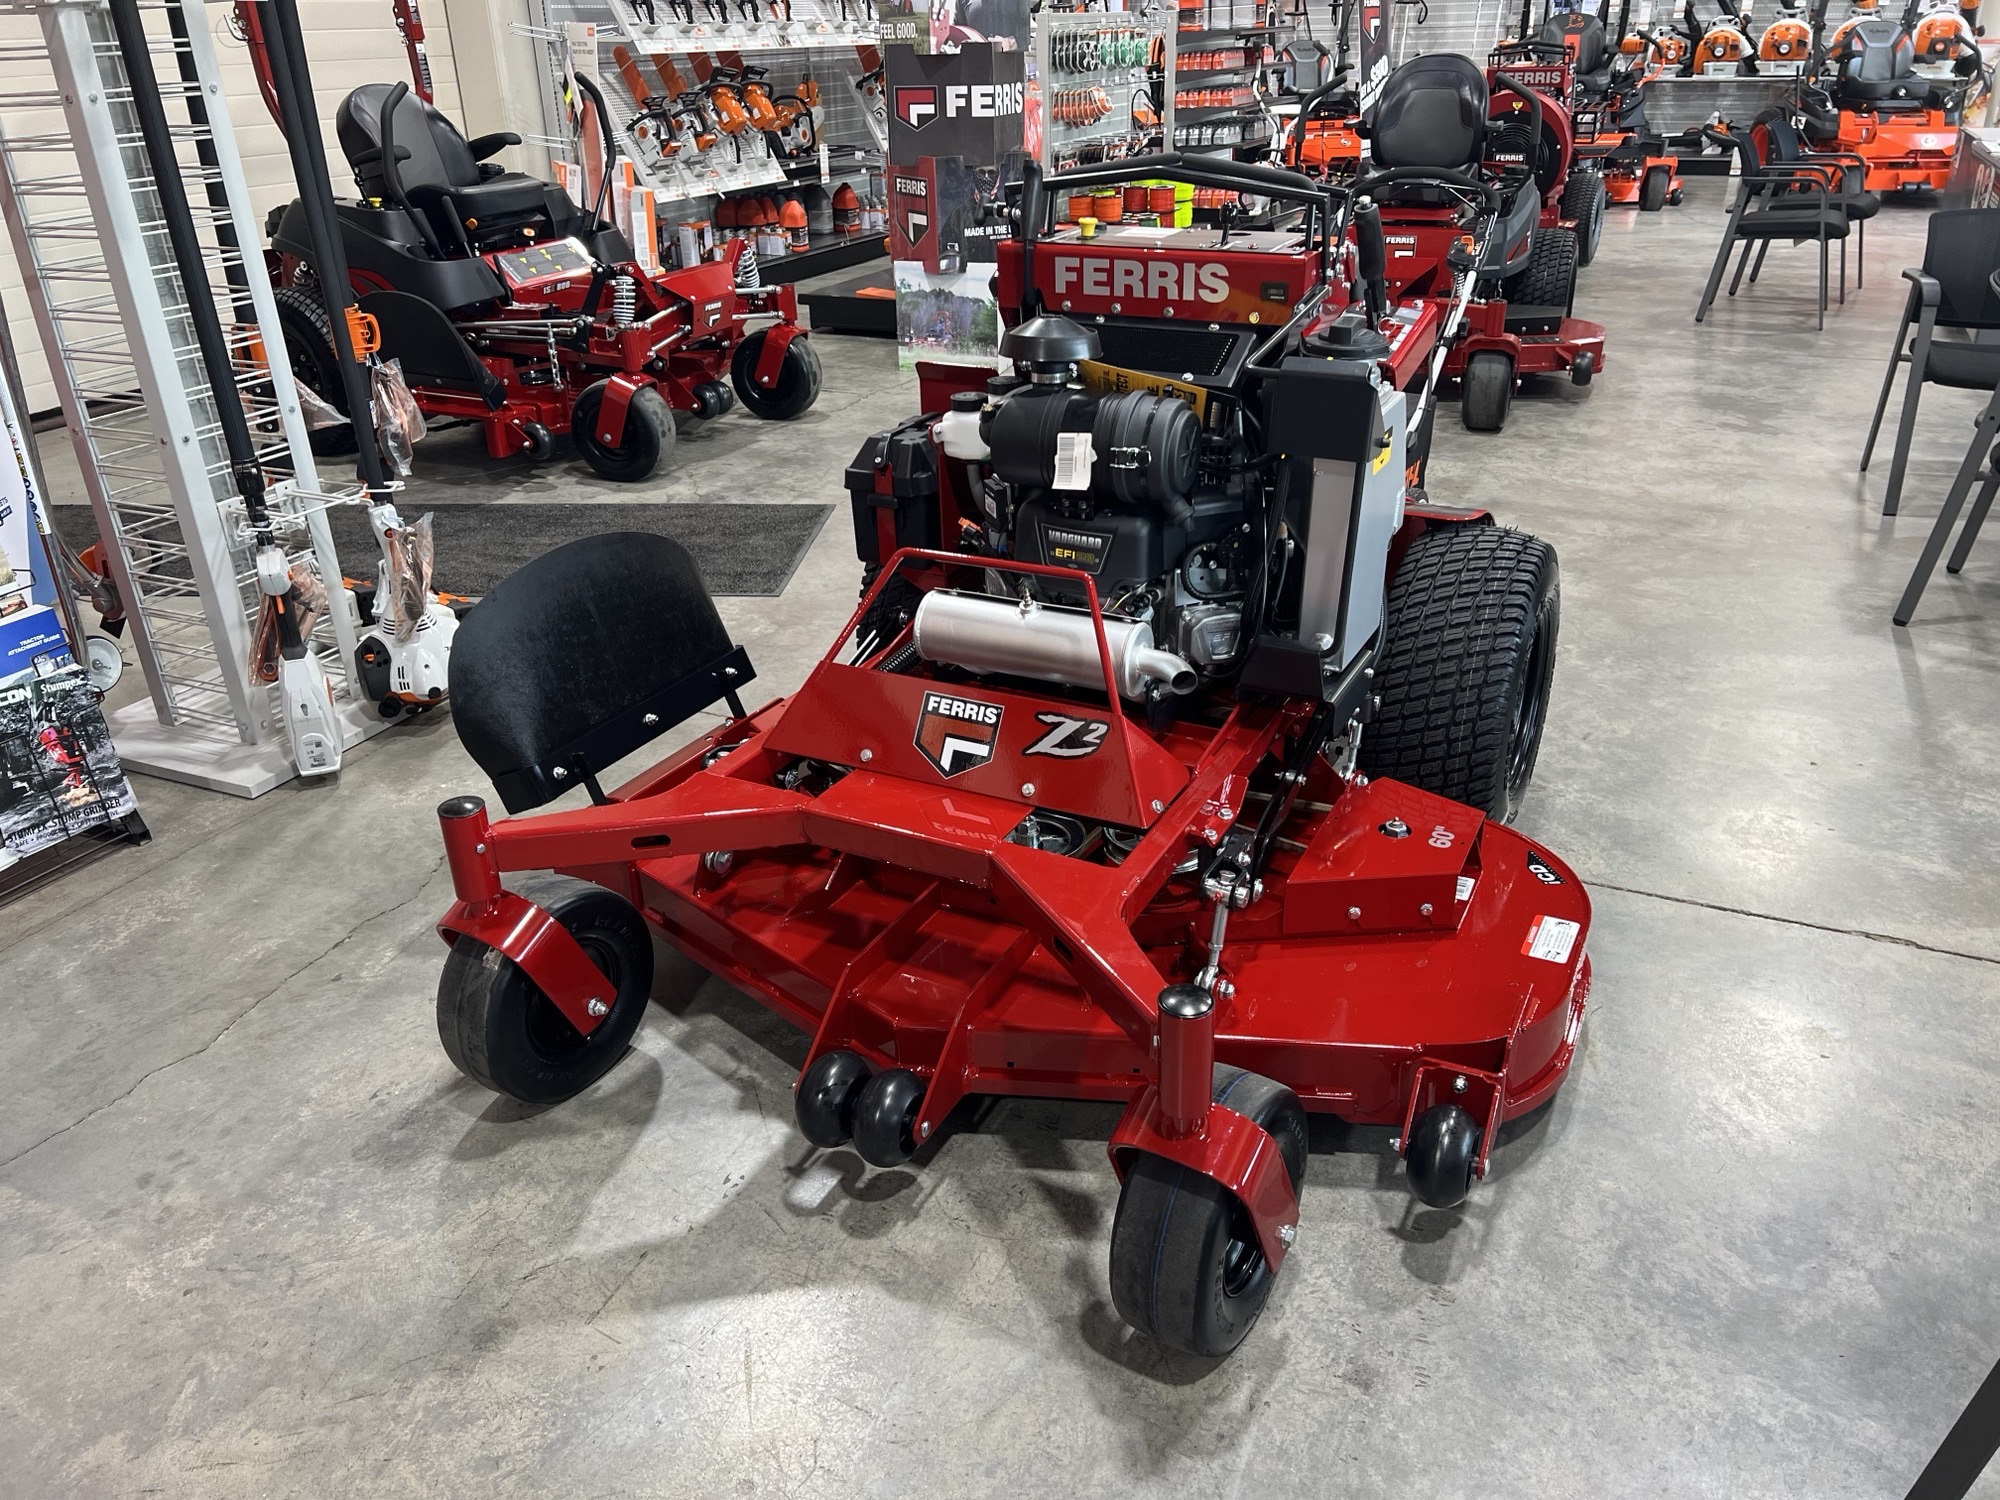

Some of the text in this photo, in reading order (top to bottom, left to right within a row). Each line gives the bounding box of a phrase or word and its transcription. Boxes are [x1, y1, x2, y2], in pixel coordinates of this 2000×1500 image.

[880, 22, 918, 39] FEEL GOOD.
[946, 82, 1023, 118] FERRIS
[896, 178, 926, 196] FERRIS
[964, 227, 984, 237] MADE
[985, 226, 993, 235] IN
[994, 225, 1008, 235] THE
[1054, 257, 1230, 303] FERRIS
[705, 302, 721, 311] FERRIS
[1048, 530, 1102, 549] VANGUARD
[1055, 548, 1076, 560] EFI
[8, 634, 60, 656] ATTACHMENT GUIDE
[20, 634, 45, 646] TRACTOR
[927, 696, 998, 724] FERRIS
[8, 799, 121, 843] STUMPEX STUMP GRINDER
[1428, 825, 1455, 849] 60"
[1528, 864, 1561, 885] iCD
